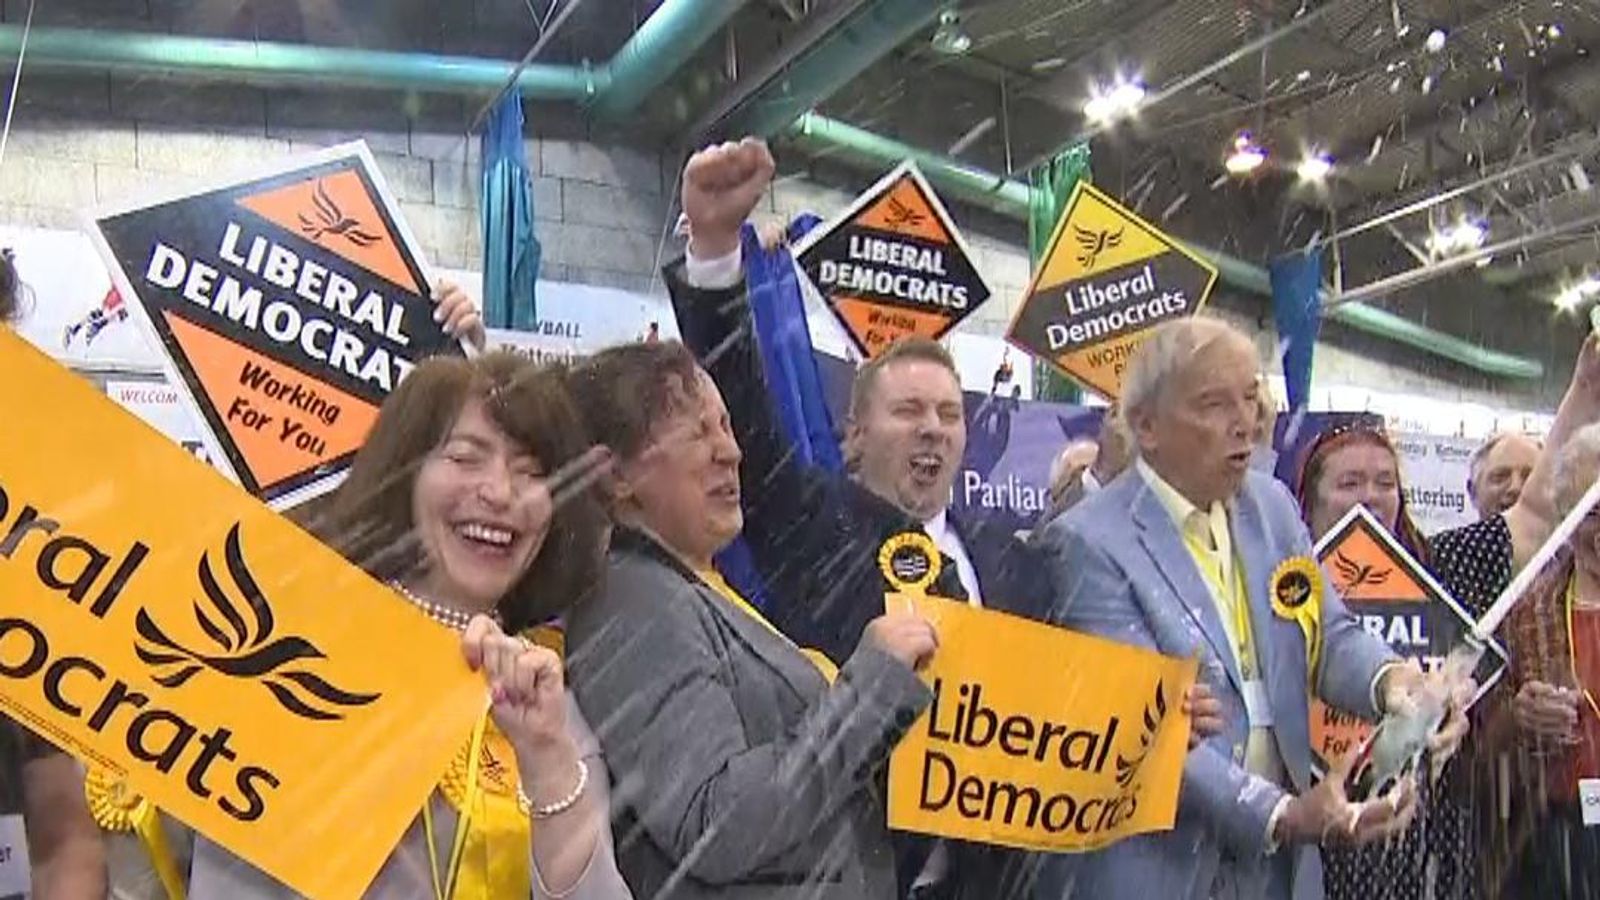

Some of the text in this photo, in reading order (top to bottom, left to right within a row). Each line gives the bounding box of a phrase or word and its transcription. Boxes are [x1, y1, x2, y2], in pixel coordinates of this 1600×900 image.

[849, 235, 946, 276] LIBERAL
[219, 222, 410, 346] LIBERAL
[819, 260, 968, 310] DEMOCRATS
[1064, 265, 1155, 316] Liberal
[1046, 290, 1187, 350] Democrats
[239, 361, 341, 426] Working
[227, 396, 328, 457] For You
[1402, 486, 1465, 513] ettering
[1357, 614, 1430, 645] RAL
[926, 677, 1119, 774] Liberal
